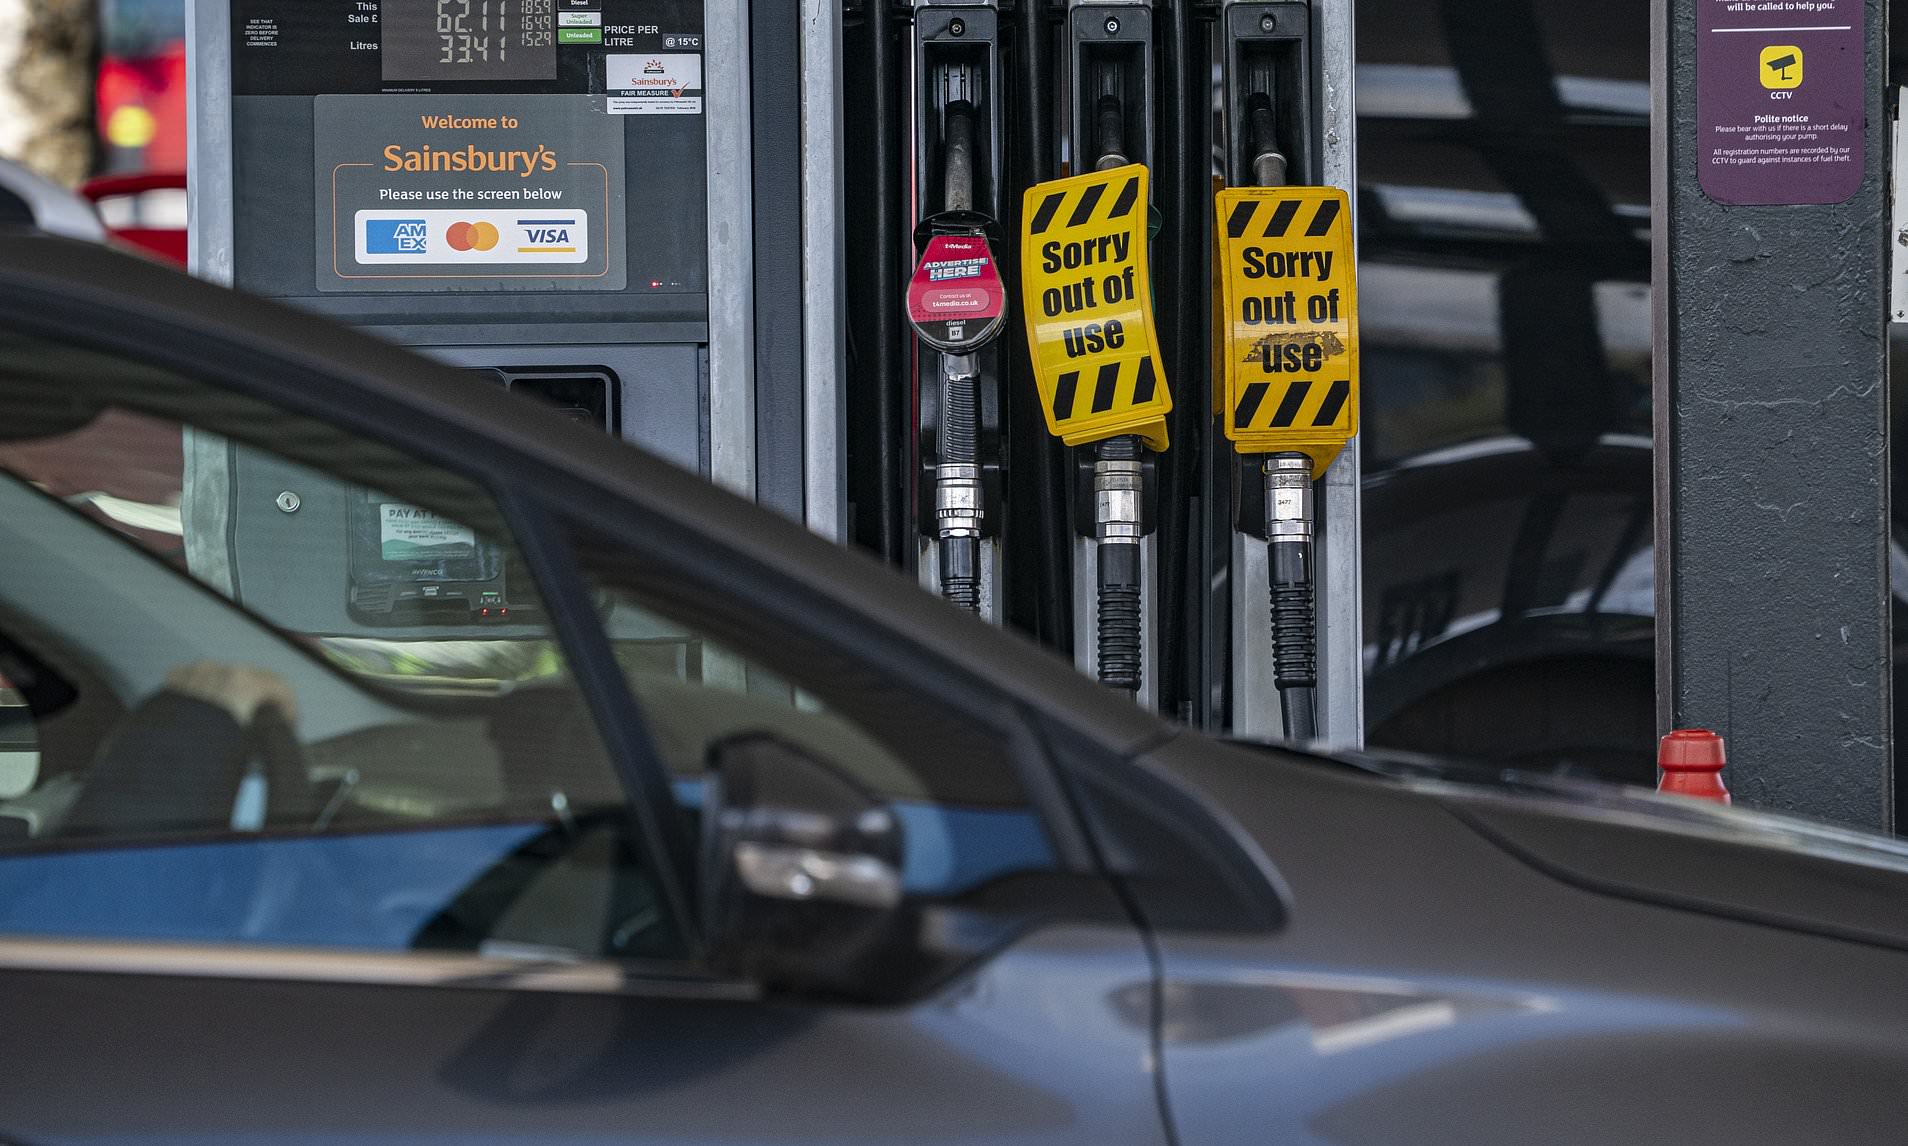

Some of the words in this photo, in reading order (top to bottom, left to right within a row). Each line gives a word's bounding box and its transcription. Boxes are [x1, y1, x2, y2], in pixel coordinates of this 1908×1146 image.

[356, 2, 378, 11] This
[1727, 3, 1743, 11] will
[1745, 3, 1755, 11] be
[1757, 2, 1783, 10] called
[1796, 2, 1815, 11] help
[1816, 2, 1835, 11] you.
[348, 14, 370, 23] Sale
[372, 14, 378, 23] £
[604, 25, 635, 34] PRICE
[638, 25, 659, 34] PER
[350, 41, 378, 50] Litres
[604, 38, 634, 46] LITRE
[678, 37, 699, 46] 15°C
[1770, 91, 1793, 100] CCTV
[421, 115, 498, 129] Welcome
[501, 116, 519, 129] to
[1754, 114, 1780, 123] Polite
[1782, 114, 1809, 123] notice
[1830, 123, 1849, 132] delay
[1744, 133, 1781, 141] authorising
[1723, 149, 1759, 157] registration
[383, 144, 557, 178] Sainsbury's
[1738, 157, 1757, 165] guard
[1757, 156, 1781, 164] against
[379, 188, 423, 201] Please
[426, 191, 449, 201] use
[452, 188, 474, 200] the
[477, 191, 520, 200] screen
[523, 188, 562, 200] below
[394, 223, 427, 237] AM
[525, 229, 569, 243] VISA
[398, 237, 427, 251] EX
[1042, 231, 1131, 275] Sorry
[924, 258, 987, 270] ADVERTISE
[1242, 246, 1333, 281] Sorry
[930, 265, 980, 280] HERE
[1043, 278, 1096, 317] out
[1103, 266, 1135, 305] of
[933, 300, 978, 308] t4media.co.uk
[1242, 291, 1296, 325] out
[1308, 289, 1339, 323] of
[1063, 319, 1125, 358] use
[1262, 342, 1322, 374] use
[389, 509, 410, 518] PAY
[413, 510, 427, 519] AT
